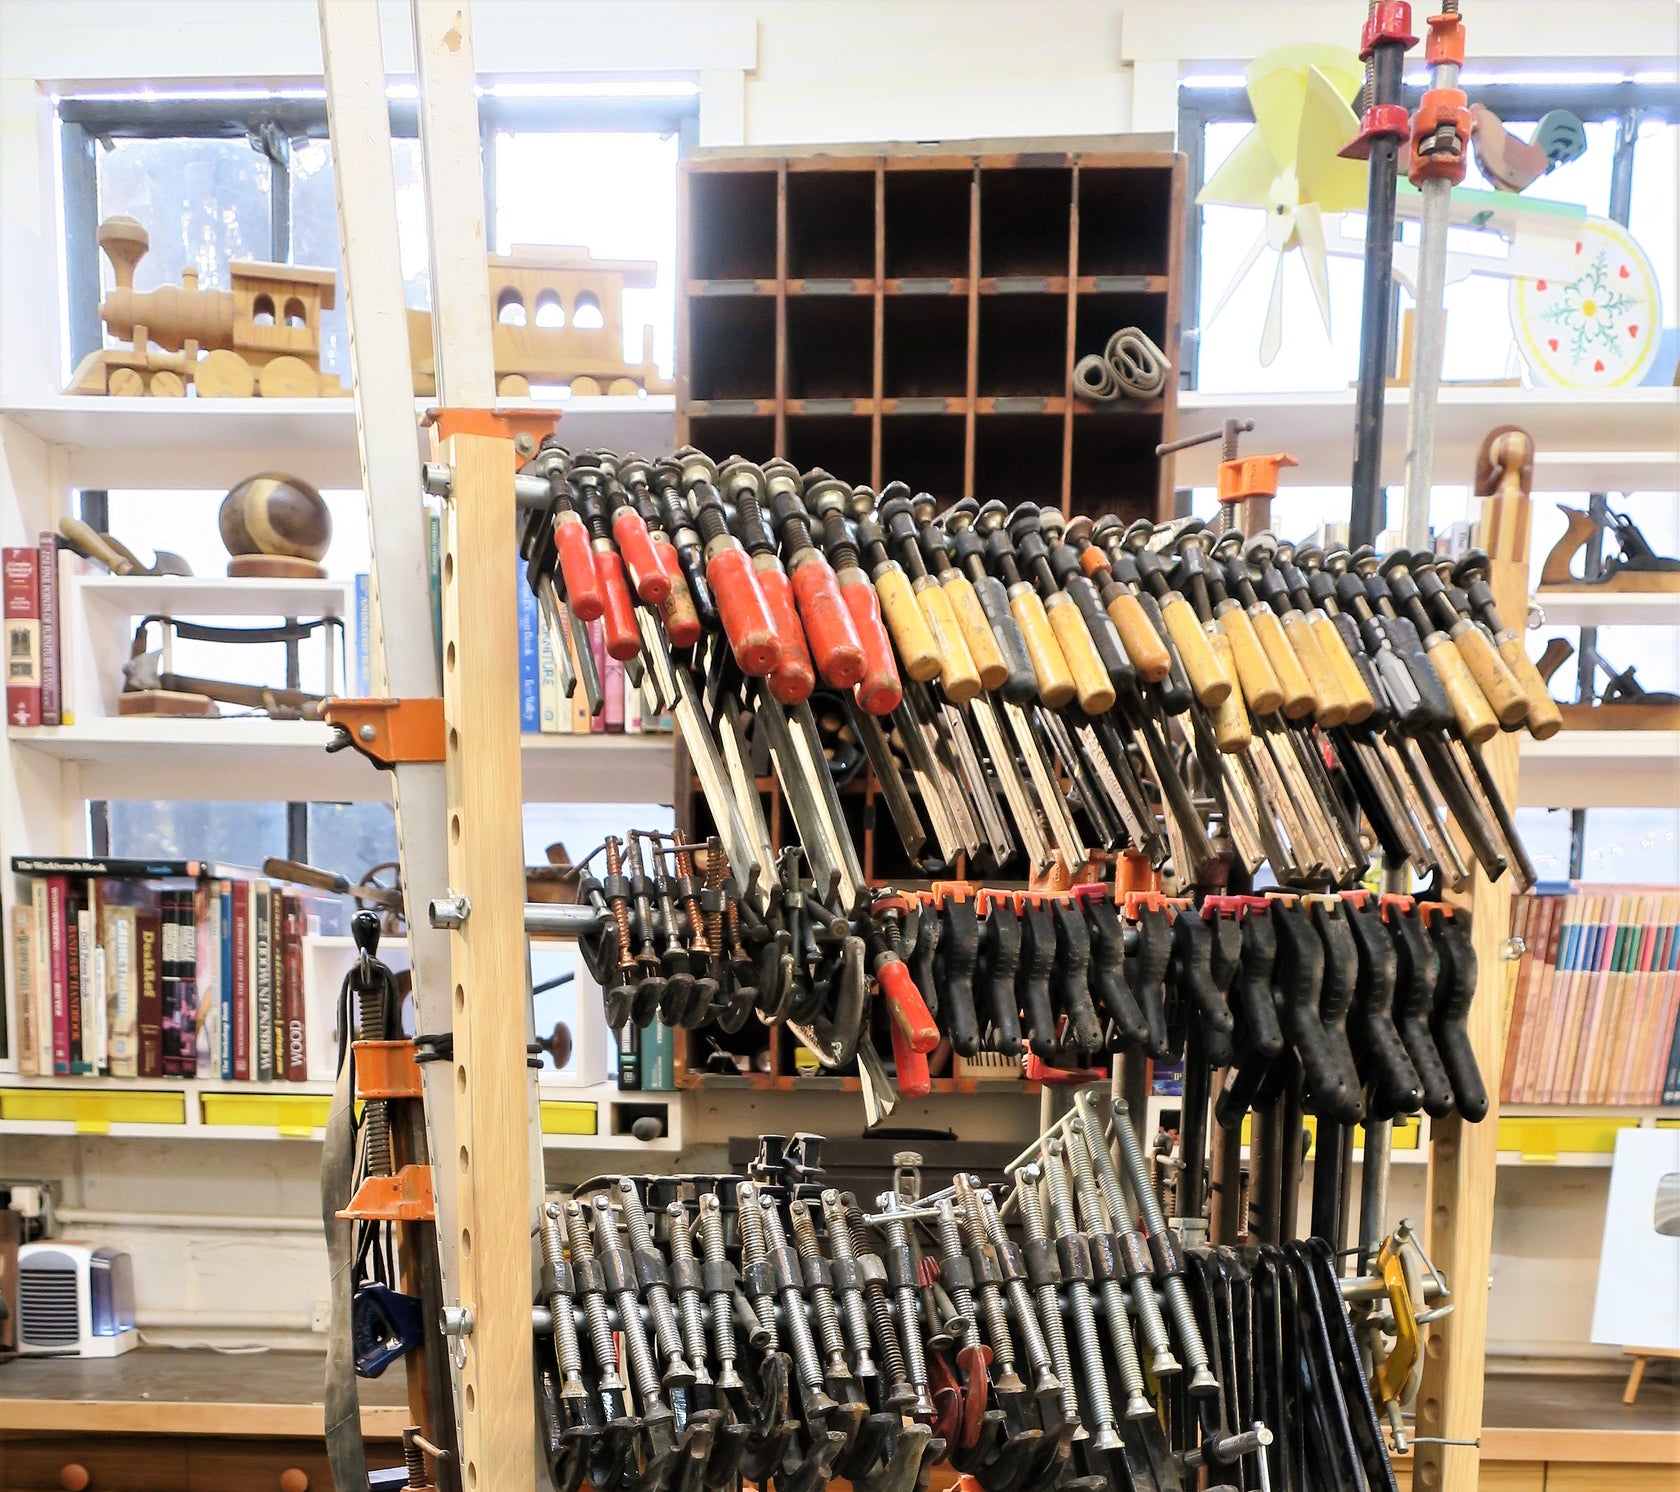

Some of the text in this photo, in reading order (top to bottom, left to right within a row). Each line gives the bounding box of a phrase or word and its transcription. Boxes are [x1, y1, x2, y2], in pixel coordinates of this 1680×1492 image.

[16, 860, 33, 870] The
[257, 940, 269, 984] WOOD
[70, 980, 80, 1042] HANDBOOK
[258, 1003, 272, 1071] WORKING
[289, 1019, 303, 1068] WOOD
